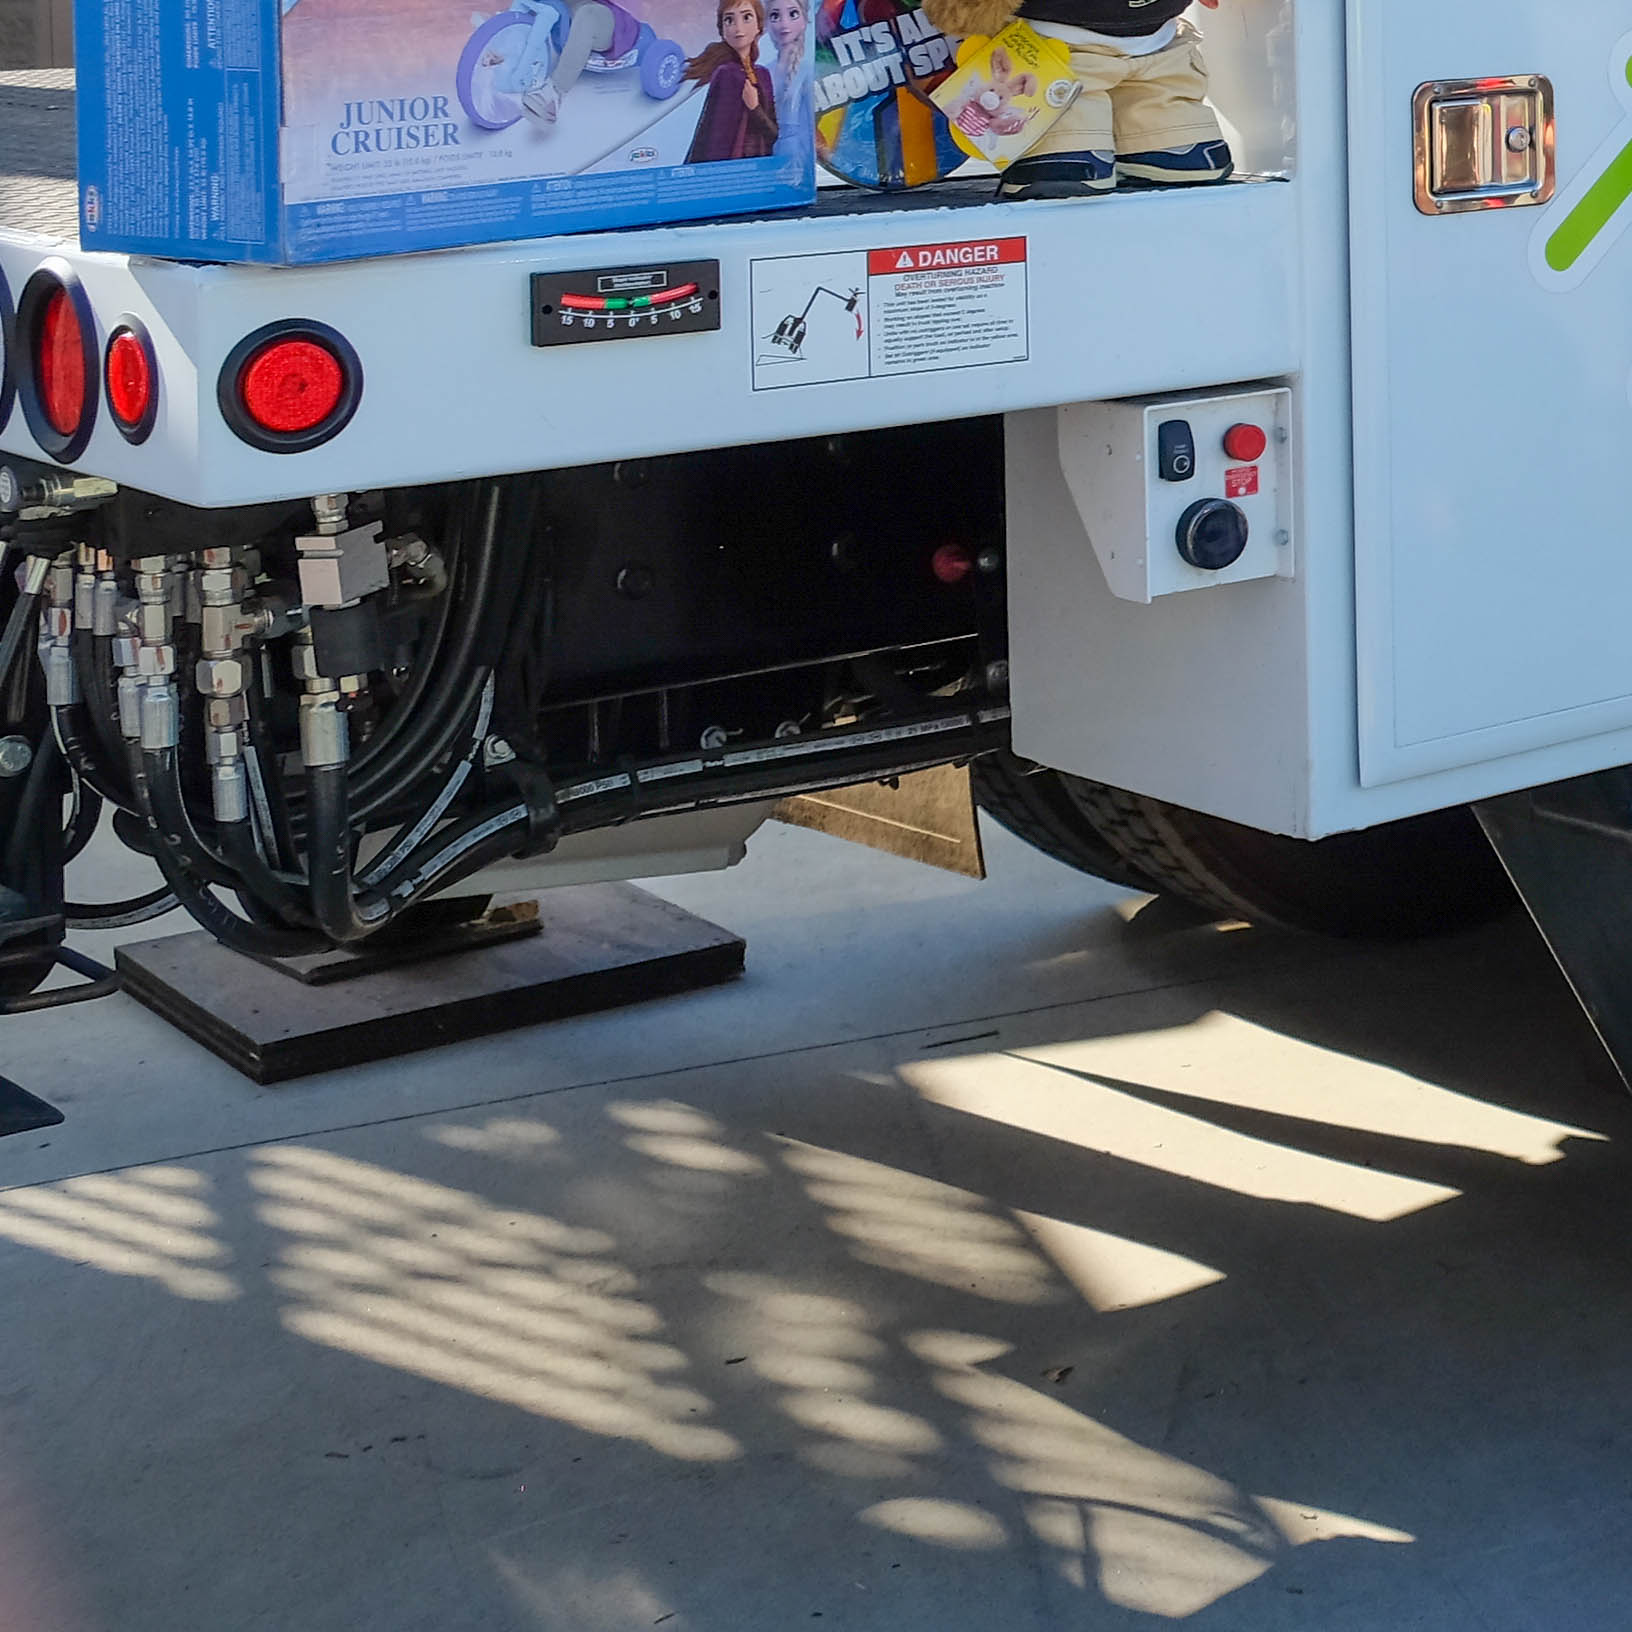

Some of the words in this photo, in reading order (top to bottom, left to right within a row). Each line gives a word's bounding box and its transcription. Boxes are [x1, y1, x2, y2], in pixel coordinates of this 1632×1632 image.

[831, 20, 899, 67] IT'S
[814, 52, 906, 114] ABOUT
[340, 96, 449, 129] JUNIOR
[331, 123, 460, 156] CRUISER
[918, 245, 999, 267] DANGER
[894, 280, 922, 291] DEATH
[924, 279, 936, 289] OR
[938, 276, 974, 287] SERIOUS
[976, 273, 1005, 284] INJURY
[903, 270, 963, 282] OVERTURNING
[965, 266, 998, 276] HAZARD
[560, 314, 573, 326] 15
[583, 316, 596, 329] 10
[606, 317, 615, 329] 5
[650, 313, 658, 325] 5
[670, 309, 682, 321] 10
[689, 302, 702, 314] 15
